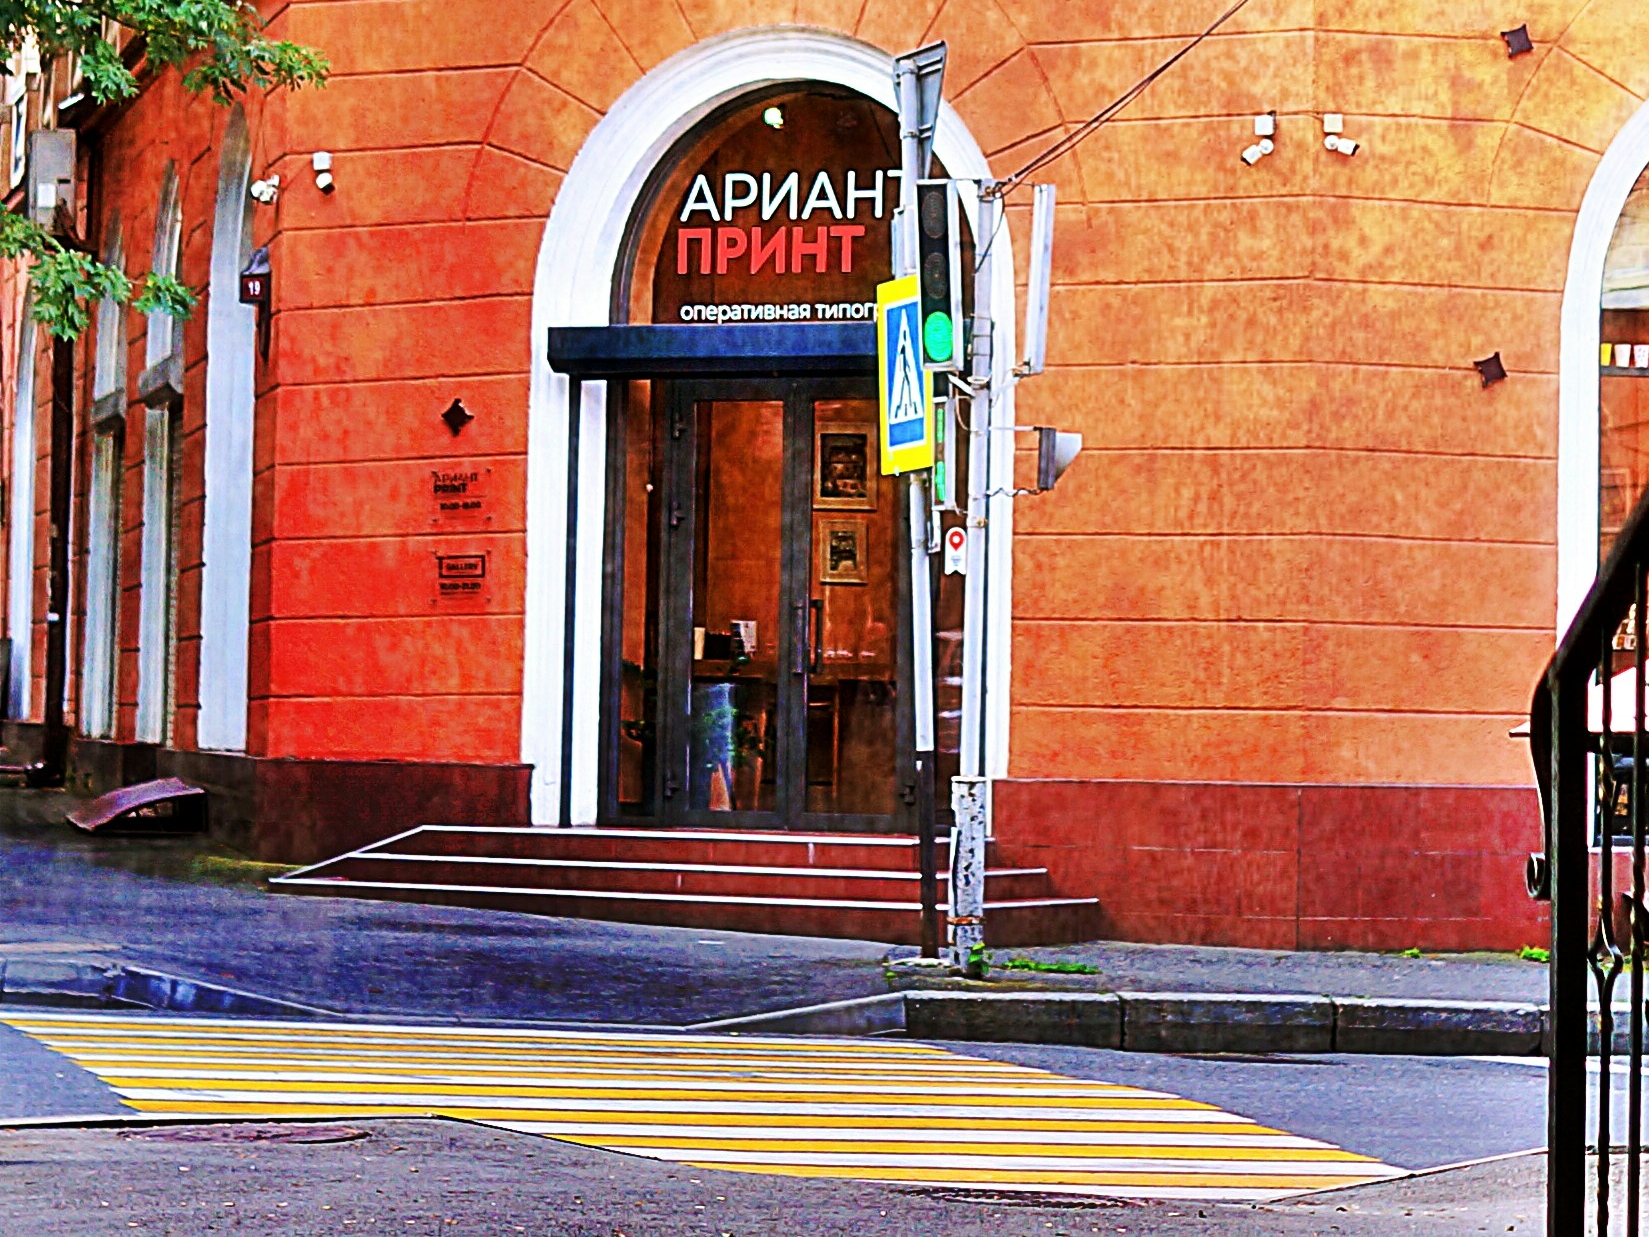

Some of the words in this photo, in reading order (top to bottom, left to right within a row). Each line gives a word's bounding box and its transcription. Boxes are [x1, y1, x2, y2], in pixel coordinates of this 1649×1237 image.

[676, 223, 866, 275] ПРИНТ
[248, 280, 260, 295] 19
[680, 303, 811, 325] оперативная
